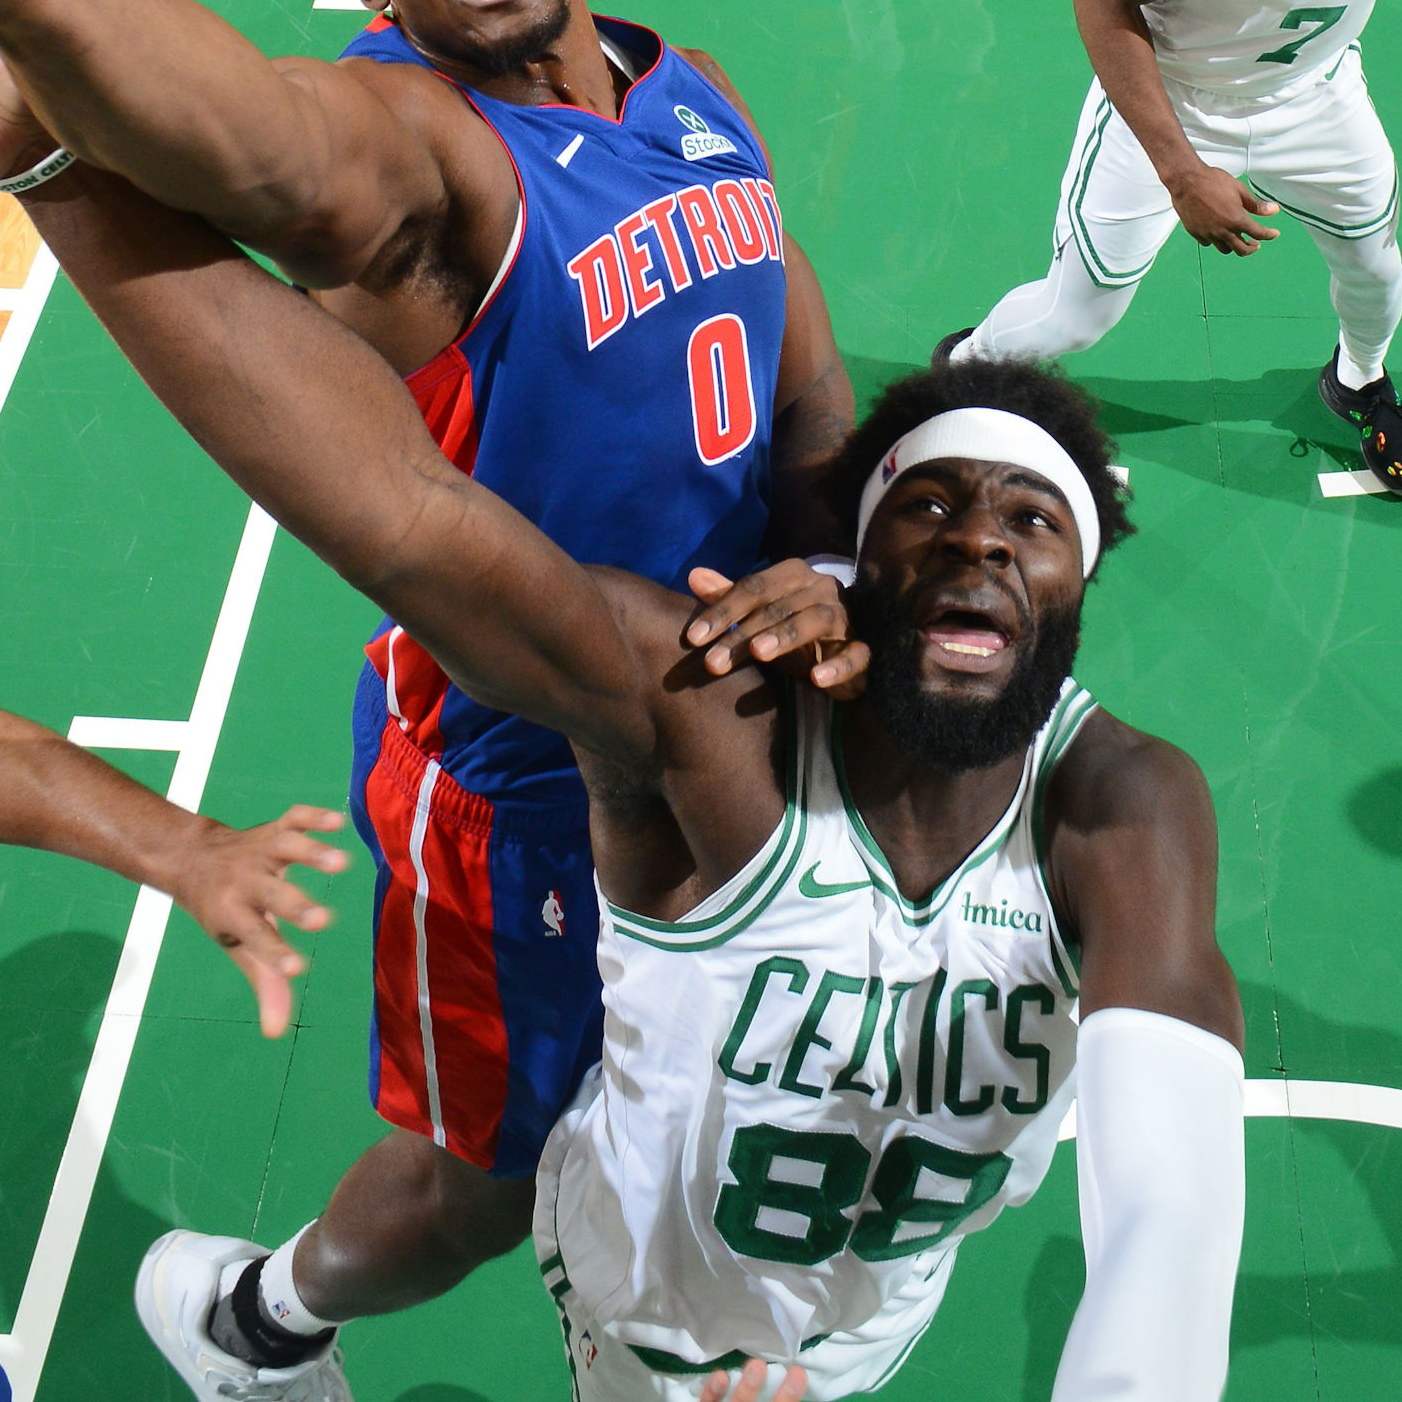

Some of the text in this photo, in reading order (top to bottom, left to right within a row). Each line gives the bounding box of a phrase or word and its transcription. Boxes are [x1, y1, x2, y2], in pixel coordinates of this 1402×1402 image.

[1255, 5, 1348, 64] 7
[567, 178, 785, 351] DETROIT
[686, 312, 757, 466] 0
[717, 956, 1054, 1116] CELTICS
[713, 1122, 1014, 1266] 88
